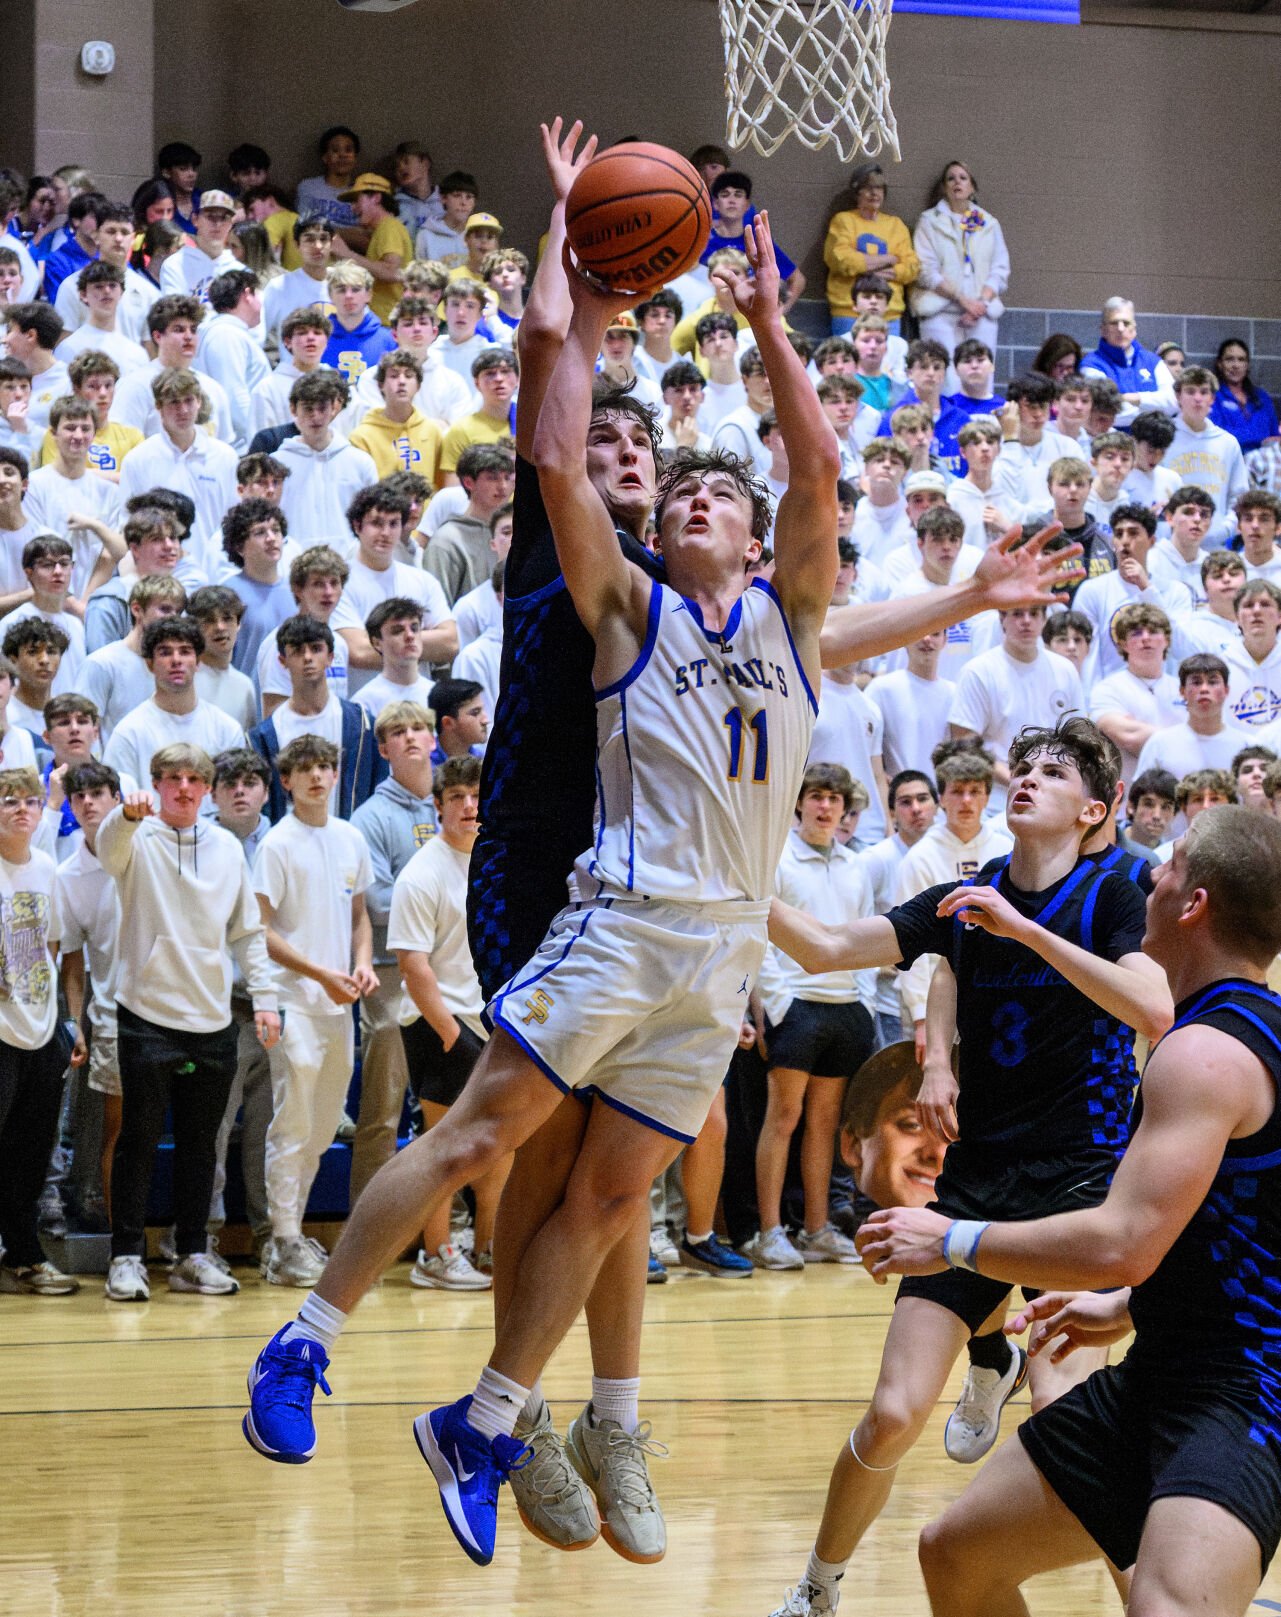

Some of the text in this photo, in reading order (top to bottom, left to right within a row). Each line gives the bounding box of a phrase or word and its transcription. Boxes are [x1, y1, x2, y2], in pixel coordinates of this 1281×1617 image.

[675, 658, 717, 697] ST.
[722, 704, 769, 785] 11
[989, 999, 1034, 1068] 3
